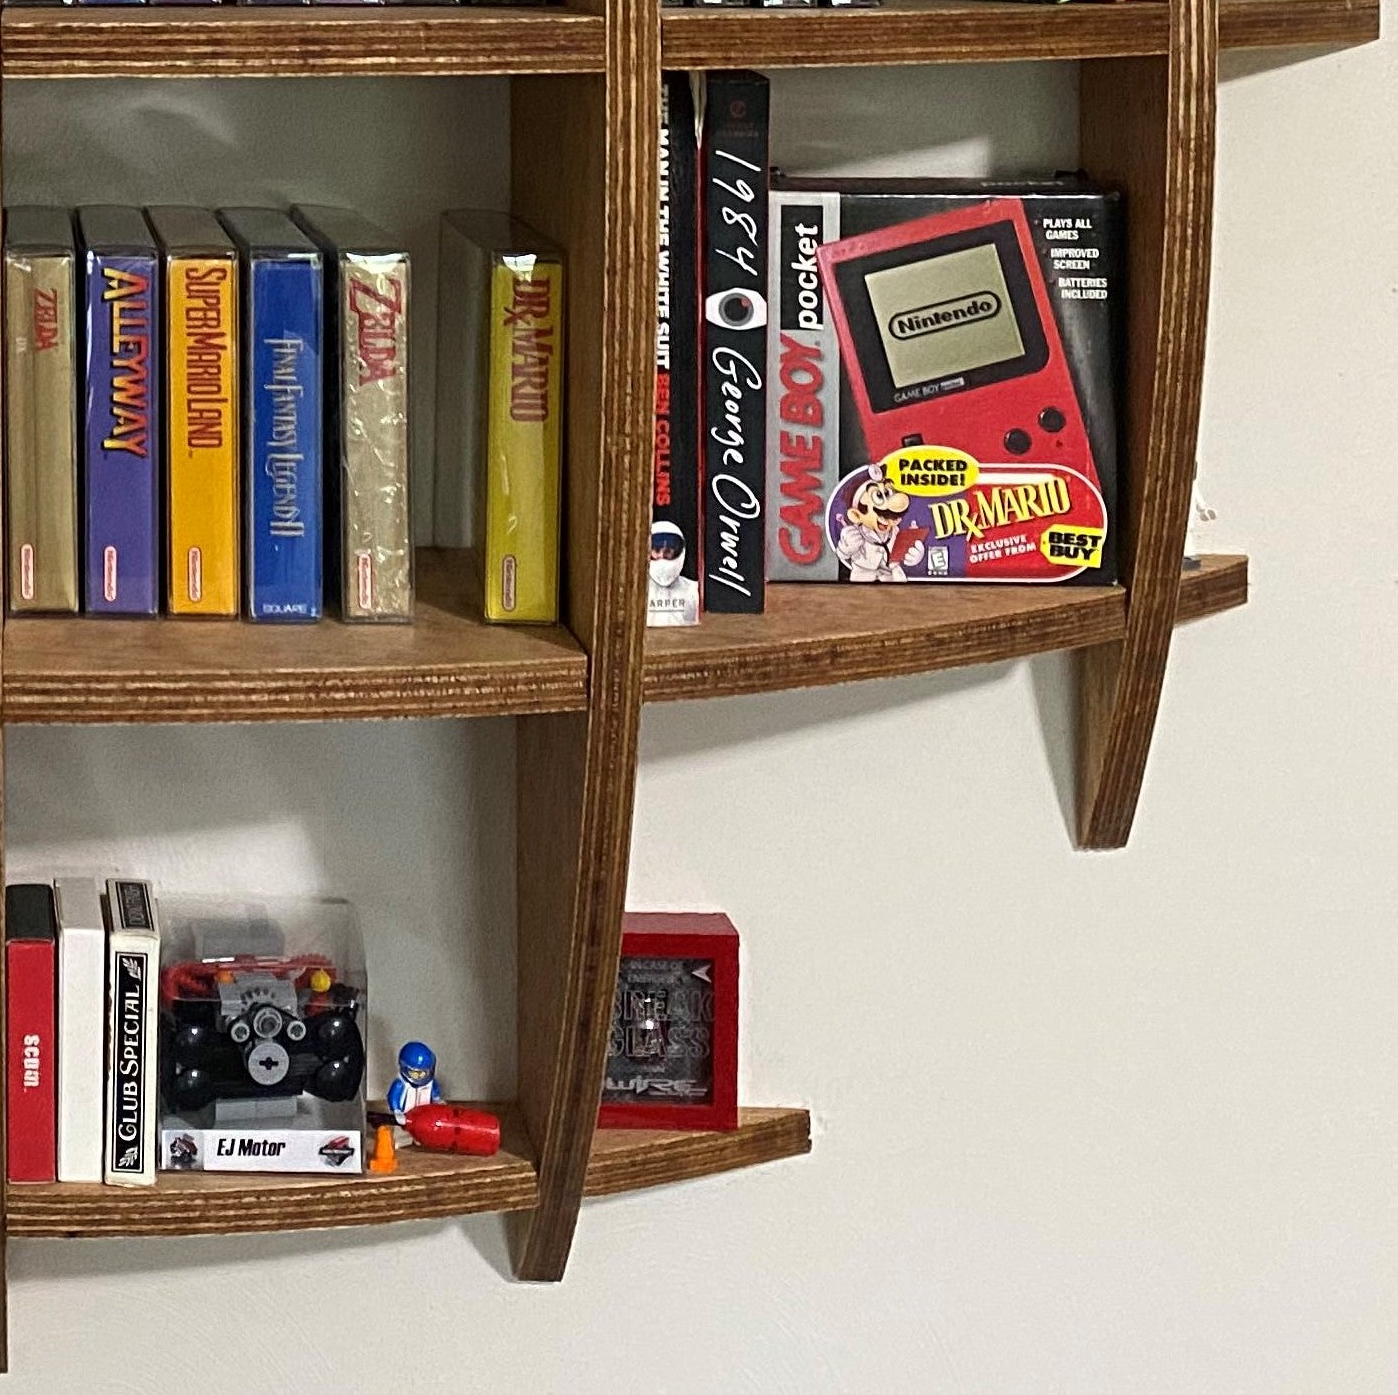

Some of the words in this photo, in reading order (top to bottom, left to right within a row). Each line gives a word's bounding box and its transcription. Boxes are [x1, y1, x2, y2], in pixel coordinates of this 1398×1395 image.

[656, 201, 670, 245] THE
[712, 149, 763, 276] 1984
[1043, 219, 1073, 229] PLAYS
[1075, 219, 1093, 229] ALL
[1046, 230, 1079, 240] GAMES
[791, 222, 824, 330] pocket
[1051, 248, 1100, 258] IMPROVED
[1053, 260, 1091, 270] SCREEN
[185, 267, 228, 329] SUPER
[656, 249, 670, 319] WHITE
[1058, 278, 1108, 288] BATTERIES
[1061, 289, 1108, 299] INCLUDED
[349, 276, 402, 387] ZELDA
[896, 298, 993, 334] Nintendo
[103, 267, 150, 457] ALLEYWAY
[263, 337, 304, 381] FINAL
[656, 324, 671, 370] SUIT
[510, 324, 554, 423] MARIO
[655, 374, 671, 416] BEN
[779, 333, 825, 427] BOY
[187, 397, 228, 449] LAND
[263, 383, 304, 449] FANTASY
[711, 347, 763, 466] George
[655, 421, 671, 505] COLLINS
[899, 459, 968, 472] PACKED
[901, 473, 966, 486] INSIDE!
[779, 432, 825, 564] GAME
[973, 477, 1073, 530] MARIO
[709, 473, 763, 597] Orwell
[969, 549, 1004, 565] OFFER
[1004, 543, 1037, 559] FROM
[970, 534, 1027, 554] EXCLUSIVE
[1049, 531, 1102, 548] BEST
[1054, 545, 1097, 561] BUY
[118, 984, 140, 1074] SPECIAL
[118, 1080, 140, 1141] CLUB
[216, 1138, 236, 1156] EJ
[237, 1138, 287, 1156] Motor
